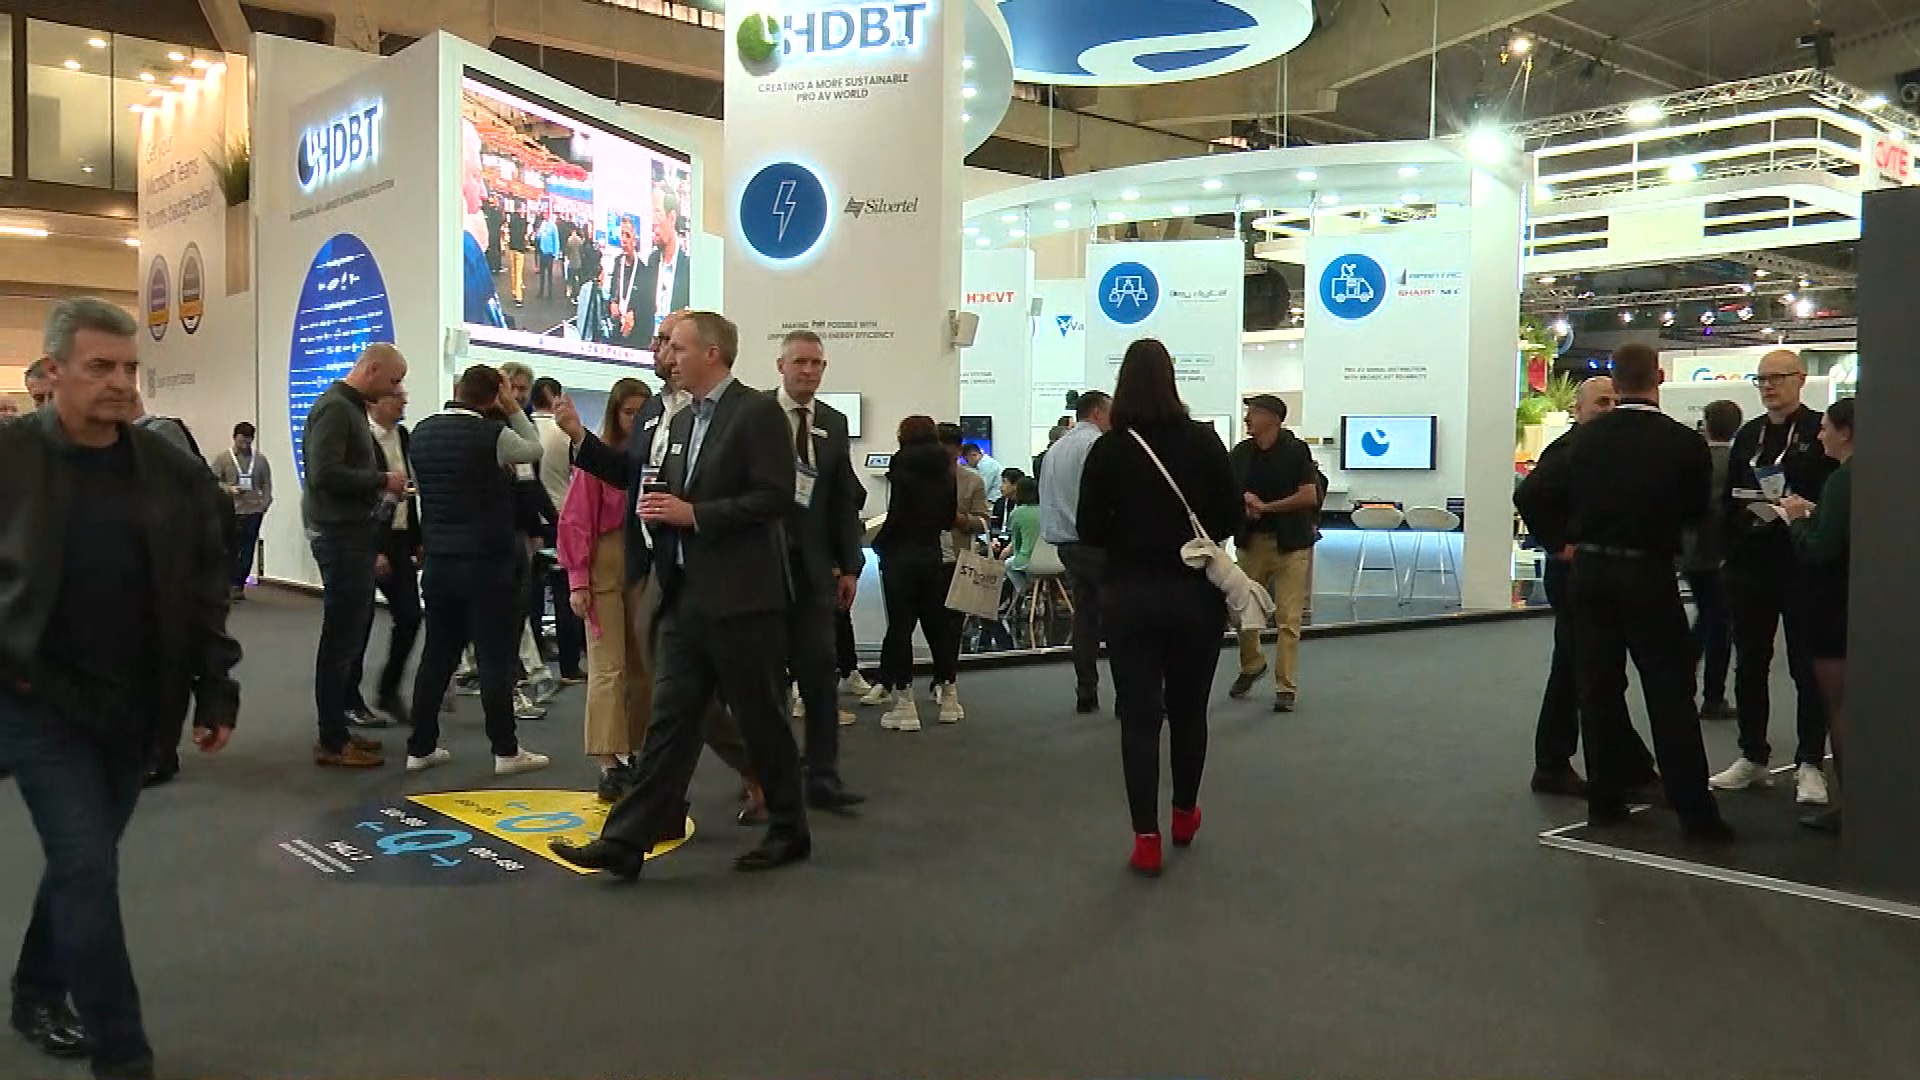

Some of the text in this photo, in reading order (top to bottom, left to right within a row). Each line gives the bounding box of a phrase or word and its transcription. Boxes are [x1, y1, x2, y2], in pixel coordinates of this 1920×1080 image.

[782, 2, 926, 55] HDBT
[758, 74, 909, 93] CREATING A MORE SUSTAINABLE
[796, 88, 869, 102] PRO AV WORLD
[316, 104, 379, 177] HDBT
[864, 197, 919, 215] Silvertel
